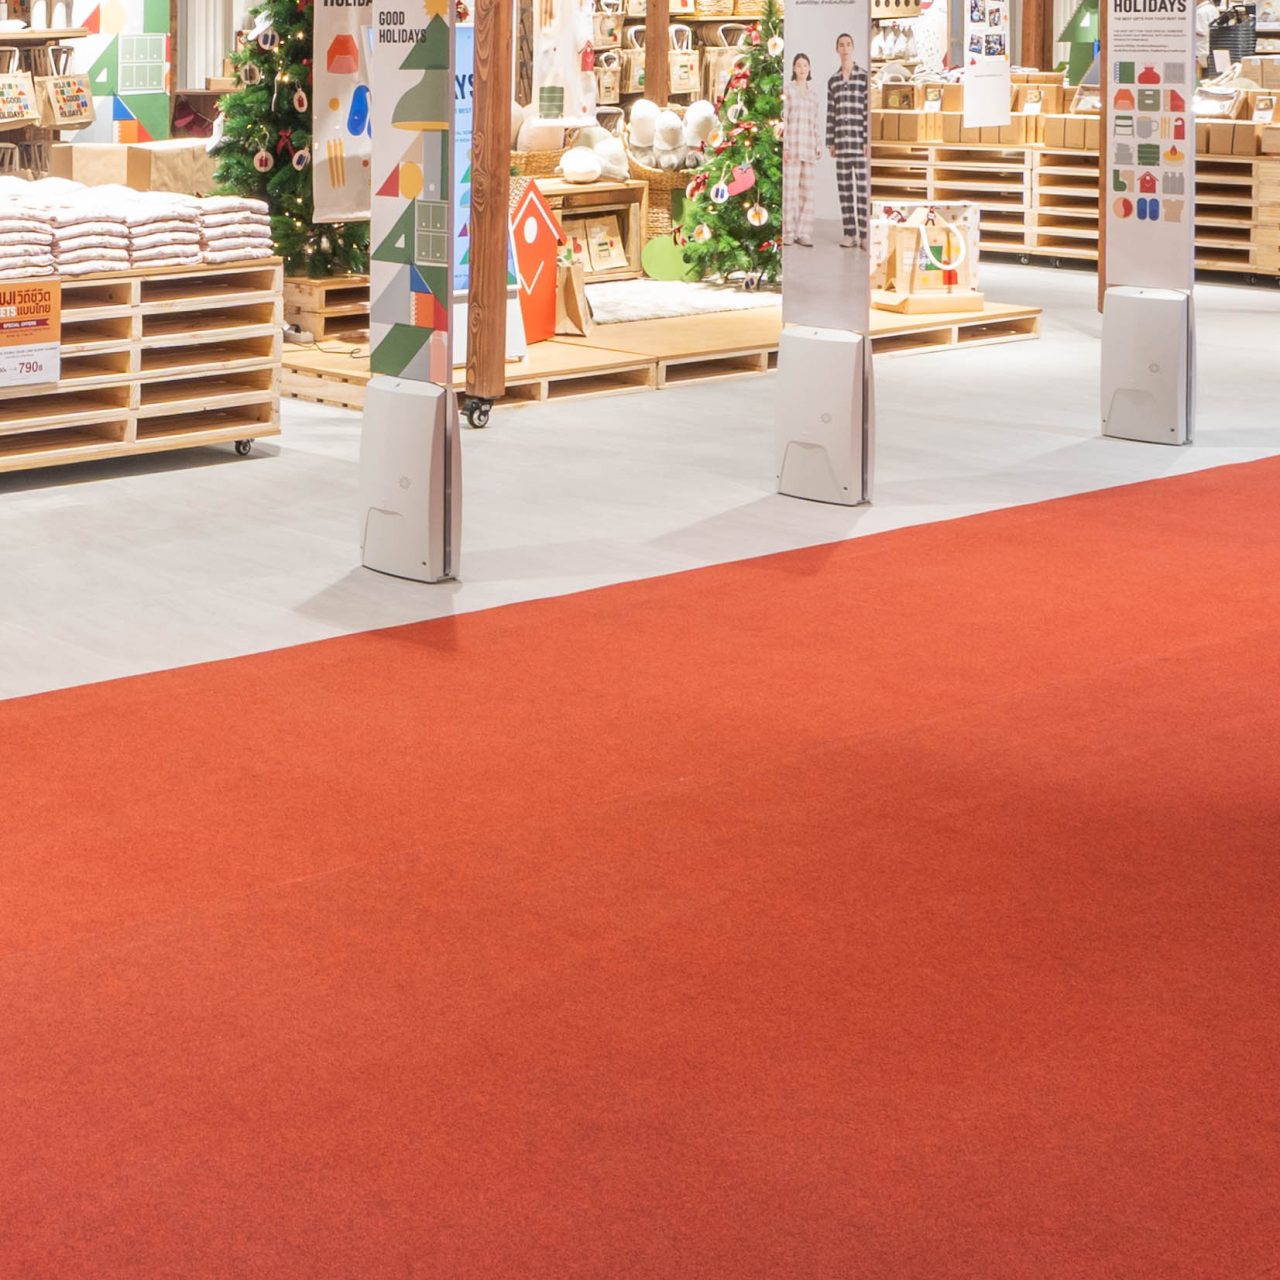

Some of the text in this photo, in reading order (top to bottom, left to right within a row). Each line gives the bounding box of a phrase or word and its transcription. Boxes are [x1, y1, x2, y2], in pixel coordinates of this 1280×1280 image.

[379, 11, 405, 25] GOOD
[379, 28, 427, 43] HOLIDAYS
[17, 288, 51, 304] วิถีชีวิต
[17, 303, 51, 316] แบบไทย
